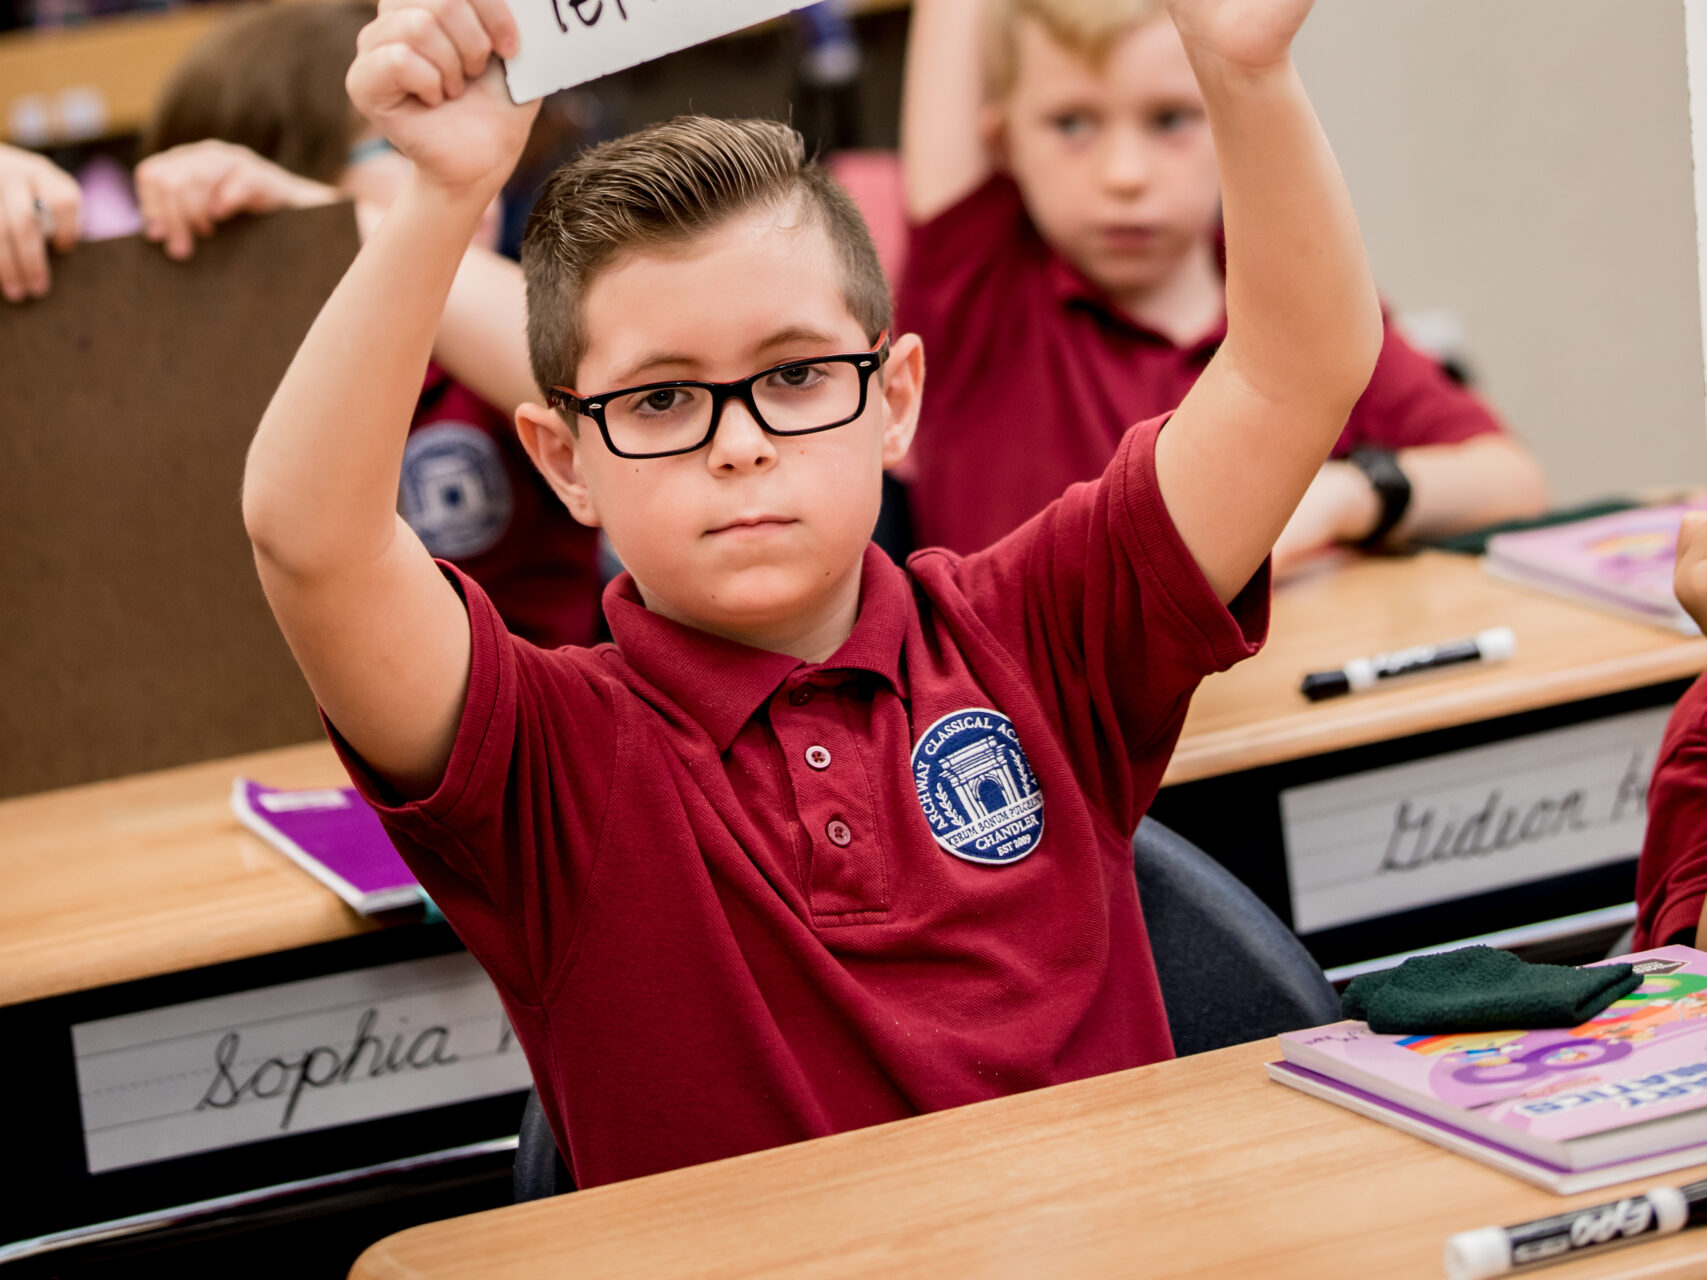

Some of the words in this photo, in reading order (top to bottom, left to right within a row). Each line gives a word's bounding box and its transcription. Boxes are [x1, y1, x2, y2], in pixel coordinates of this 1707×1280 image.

[924, 716, 994, 756] CLASSICAL
[917, 760, 949, 831] ARCHWAY
[975, 813, 1040, 850] CHANDLER
[979, 811, 1009, 831] BONUM
[1376, 787, 1592, 873] Gideon
[996, 841, 1014, 857] EST
[194, 1007, 460, 1131] Sophia
